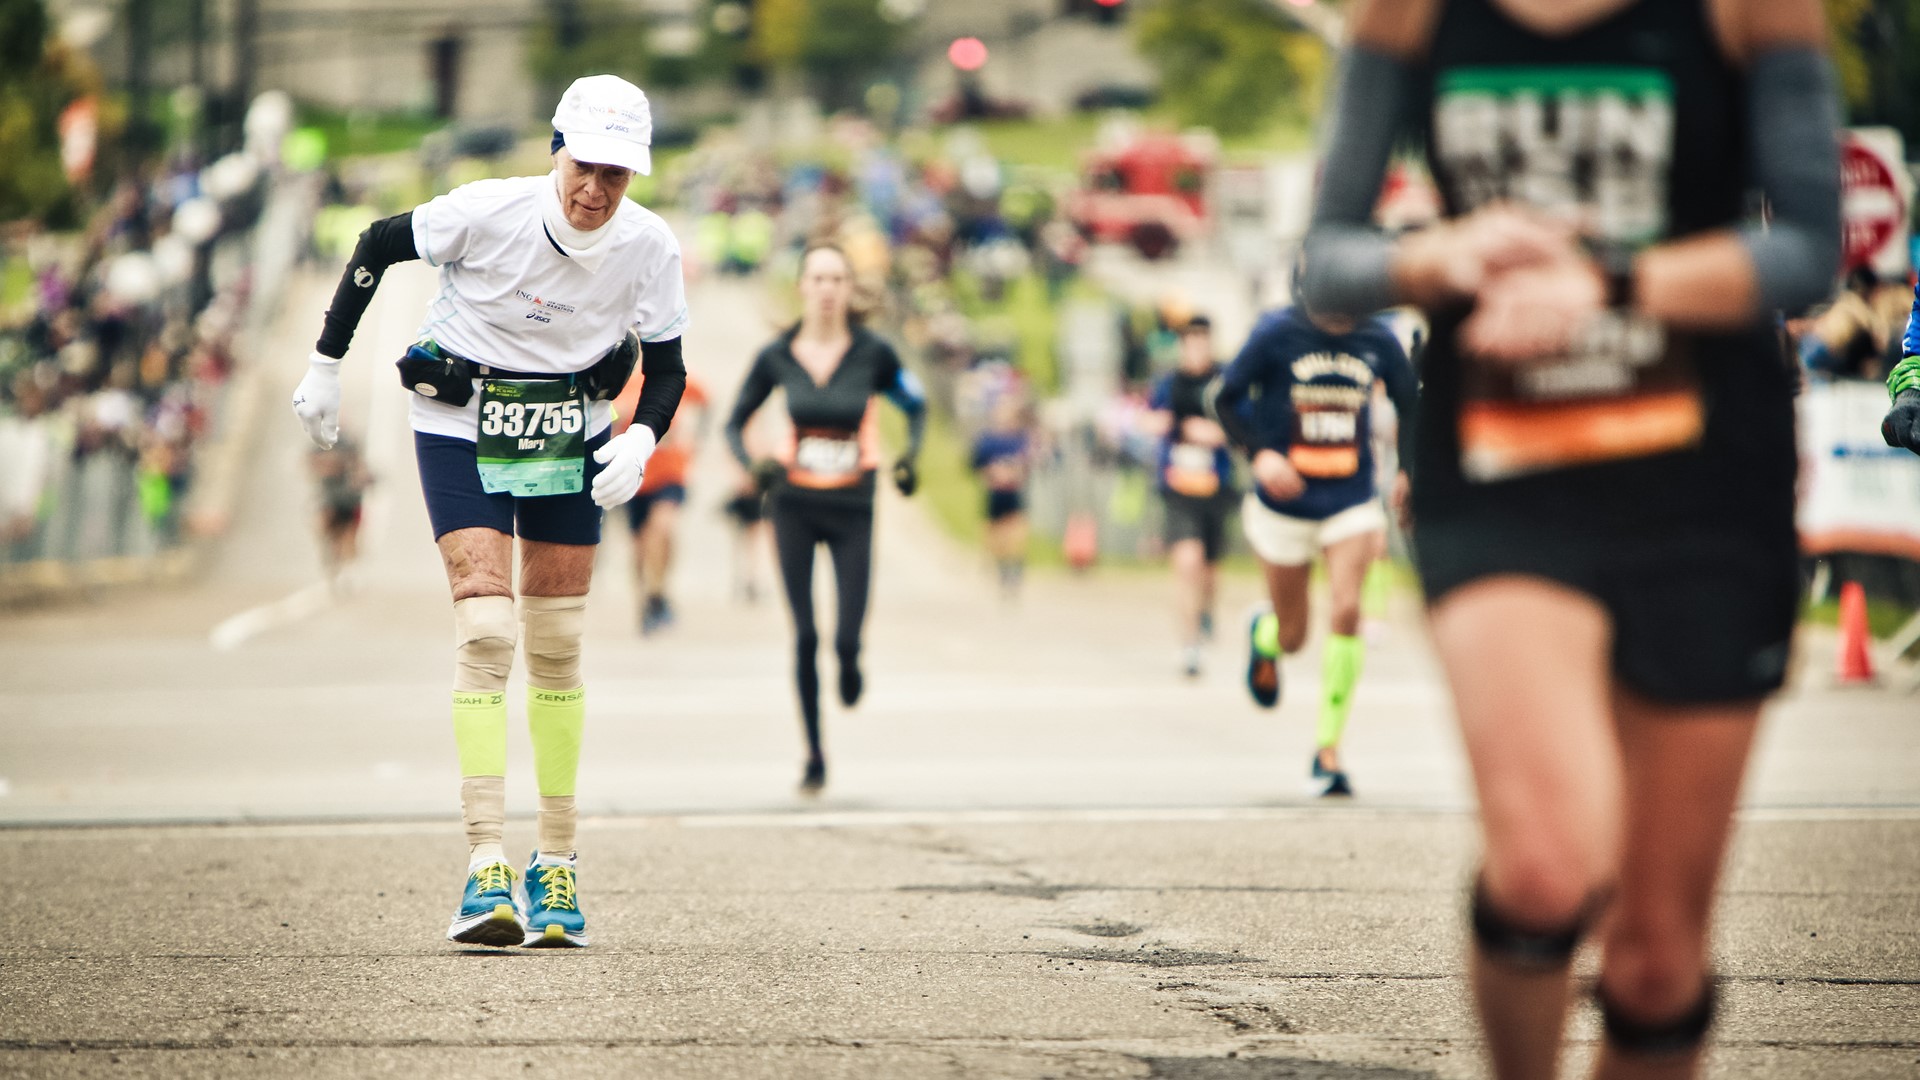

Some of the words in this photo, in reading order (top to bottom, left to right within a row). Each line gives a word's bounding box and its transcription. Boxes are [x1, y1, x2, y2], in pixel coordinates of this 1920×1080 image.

[515, 290, 533, 301] ING
[546, 303, 574, 313] MARATHON
[481, 400, 583, 437] 33755
[518, 438, 545, 450] Mary
[535, 691, 585, 702] ZENSA
